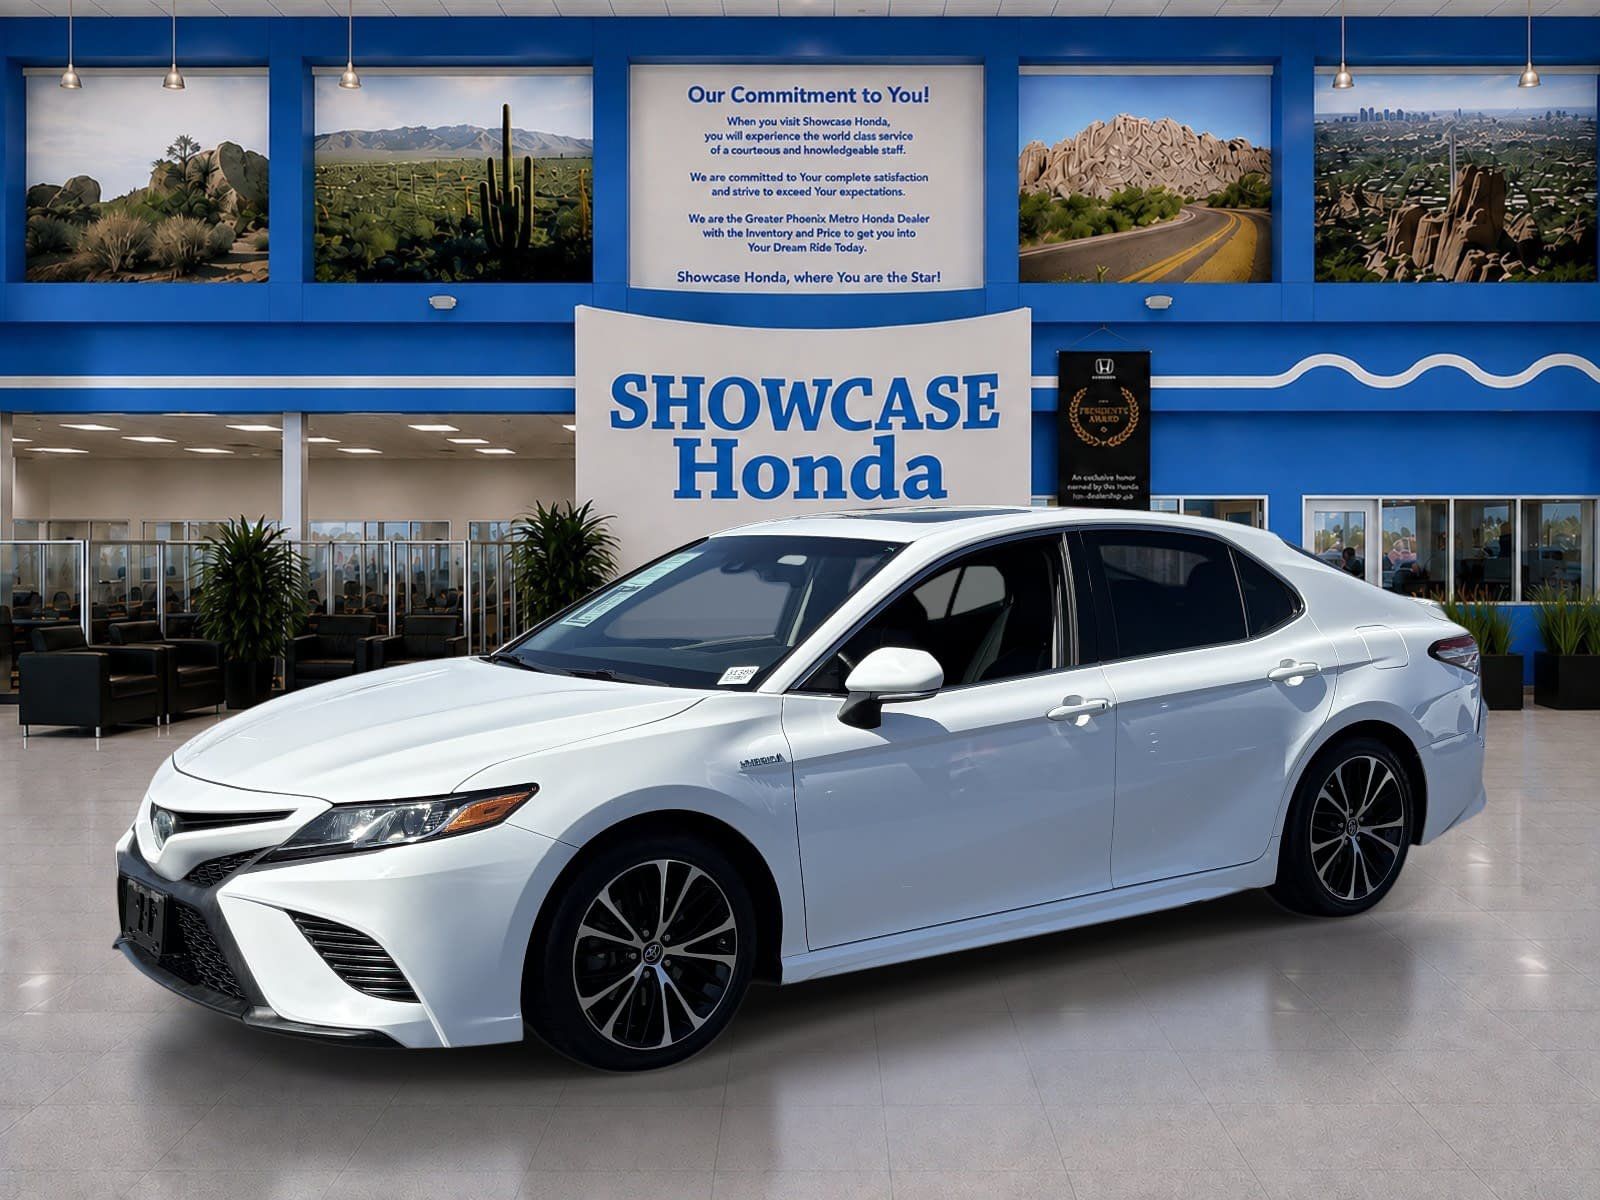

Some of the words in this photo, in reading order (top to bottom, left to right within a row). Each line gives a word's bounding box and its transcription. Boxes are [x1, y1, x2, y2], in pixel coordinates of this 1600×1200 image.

[688, 86, 726, 103] Our
[731, 86, 856, 103] Commitment
[862, 88, 882, 103] to
[887, 86, 929, 103] You!
[727, 116, 756, 126] When
[759, 119, 777, 128] you
[780, 117, 800, 126] visit
[803, 117, 852, 126] Showcase
[855, 117, 890, 127] Honda,
[705, 133, 723, 143] you
[726, 131, 742, 140] will
[745, 131, 800, 143] experience
[803, 131, 819, 140] the
[822, 131, 850, 141] world
[853, 131, 876, 141] class
[879, 131, 913, 141] service
[710, 145, 721, 154] of
[731, 147, 780, 155] courteous
[783, 145, 801, 154] and
[882, 145, 905, 154] staff.
[690, 173, 707, 182] We
[729, 172, 783, 182] committed
[786, 174, 797, 182] to
[800, 173, 822, 182] Your
[825, 173, 871, 184] complete
[874, 172, 928, 182] satisfaction
[712, 186, 730, 196] and
[733, 187, 760, 196] strive
[763, 188, 773, 196] to
[776, 187, 811, 196] exceed
[814, 187, 837, 196] Your
[839, 187, 905, 199] expectations.
[689, 214, 705, 224] We
[726, 214, 743, 223] the
[745, 214, 784, 223] Greater
[786, 214, 826, 223] Phoenix
[829, 214, 859, 223] Metro
[862, 214, 894, 223] Honda
[898, 214, 930, 223] Dealer
[703, 228, 724, 237] with
[727, 228, 743, 238] the
[746, 228, 793, 240] Inventory
[795, 228, 814, 238] and
[817, 228, 841, 238] Price
[857, 229, 874, 240] get
[876, 231, 894, 240] you
[897, 228, 916, 237] into
[748, 243, 771, 252] Your
[774, 243, 807, 252] Dream
[810, 243, 832, 252] Ride
[834, 243, 867, 254] Today.
[677, 271, 740, 283] Showcase
[745, 271, 789, 285] Honda,
[794, 271, 833, 283] where
[837, 272, 860, 283] You
[864, 275, 883, 283] are
[887, 271, 907, 283] the
[912, 271, 940, 283] Star!
[610, 373, 1000, 432] SHOWCASE
[673, 434, 948, 500] Honda
